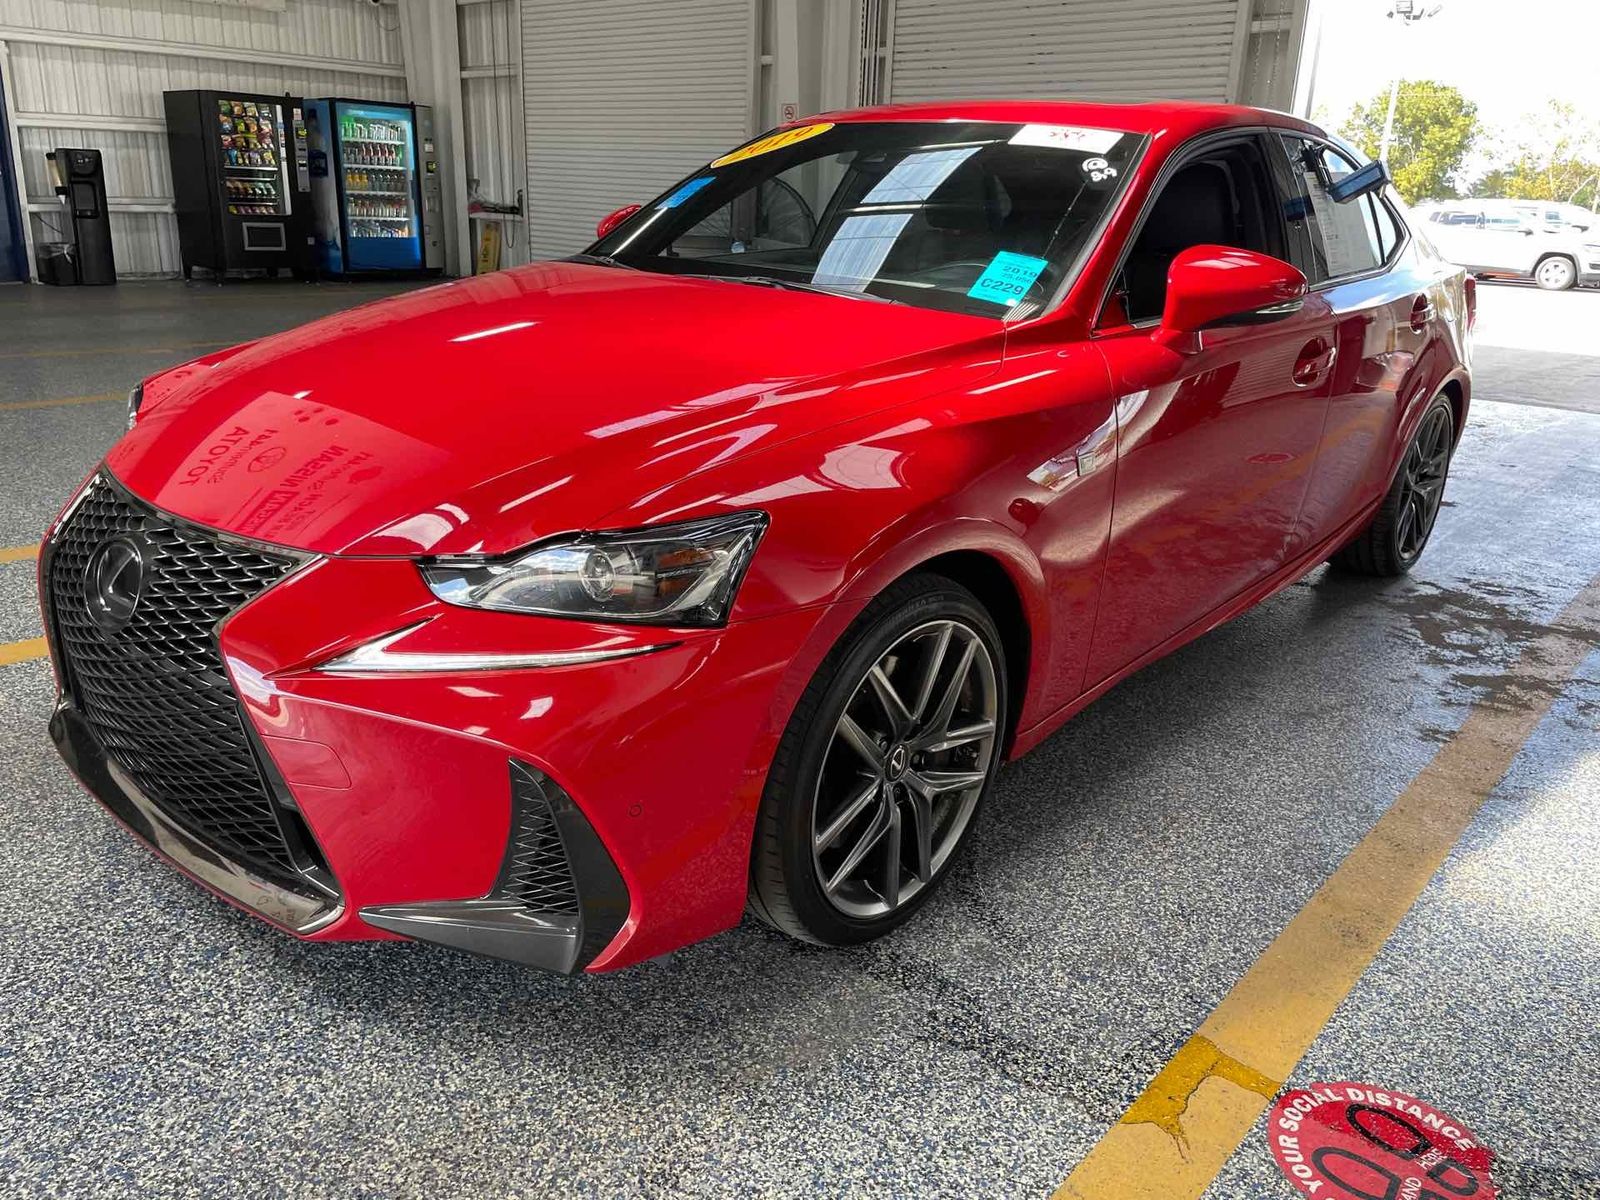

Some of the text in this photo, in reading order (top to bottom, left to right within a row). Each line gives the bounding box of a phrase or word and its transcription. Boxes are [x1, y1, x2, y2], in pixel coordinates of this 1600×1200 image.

[981, 278, 1024, 295] C229
[1278, 1087, 1477, 1194] YOUR SOCIAL DISTANCE
